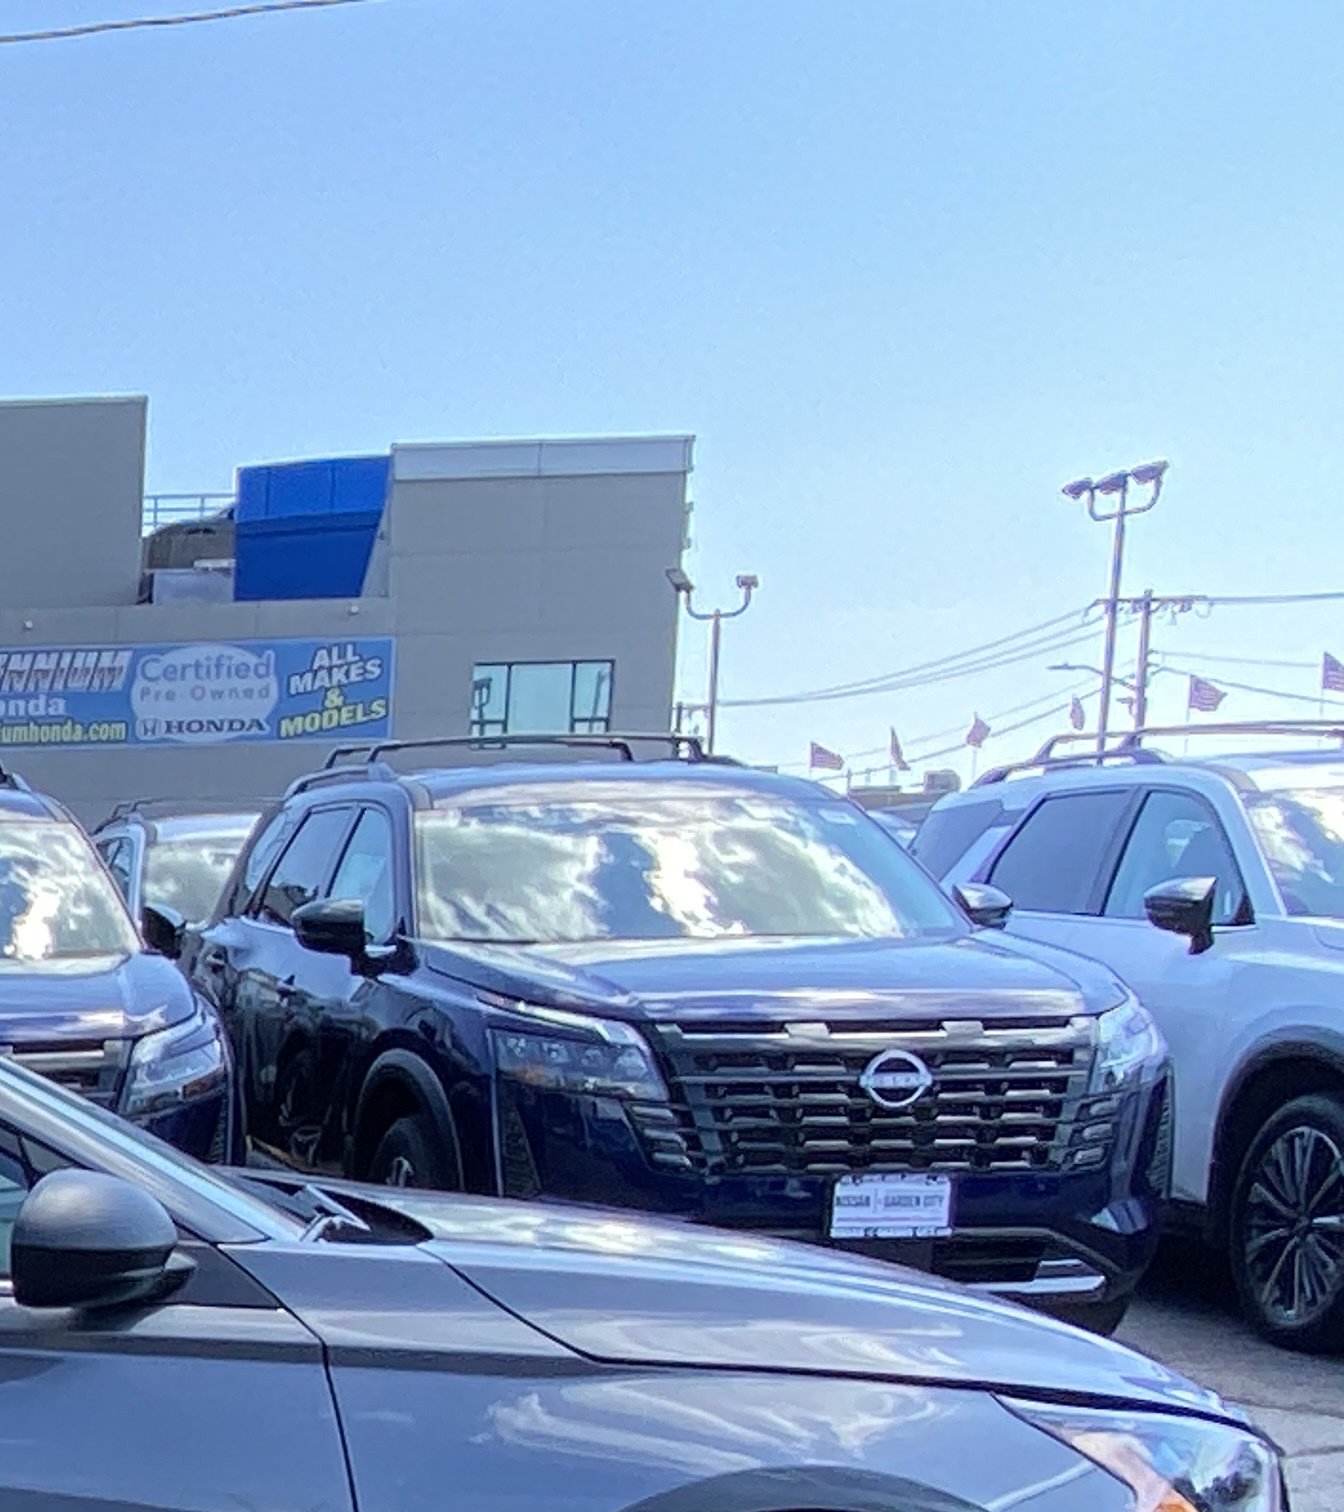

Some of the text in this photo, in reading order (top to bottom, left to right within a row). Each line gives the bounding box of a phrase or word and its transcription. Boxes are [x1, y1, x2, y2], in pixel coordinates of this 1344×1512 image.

[140, 654, 271, 682] Certified
[313, 643, 360, 670] ALL
[288, 659, 383, 696] MAKES
[323, 687, 344, 709] &
[164, 717, 267, 735] HONDA
[280, 699, 387, 738] MODELS
